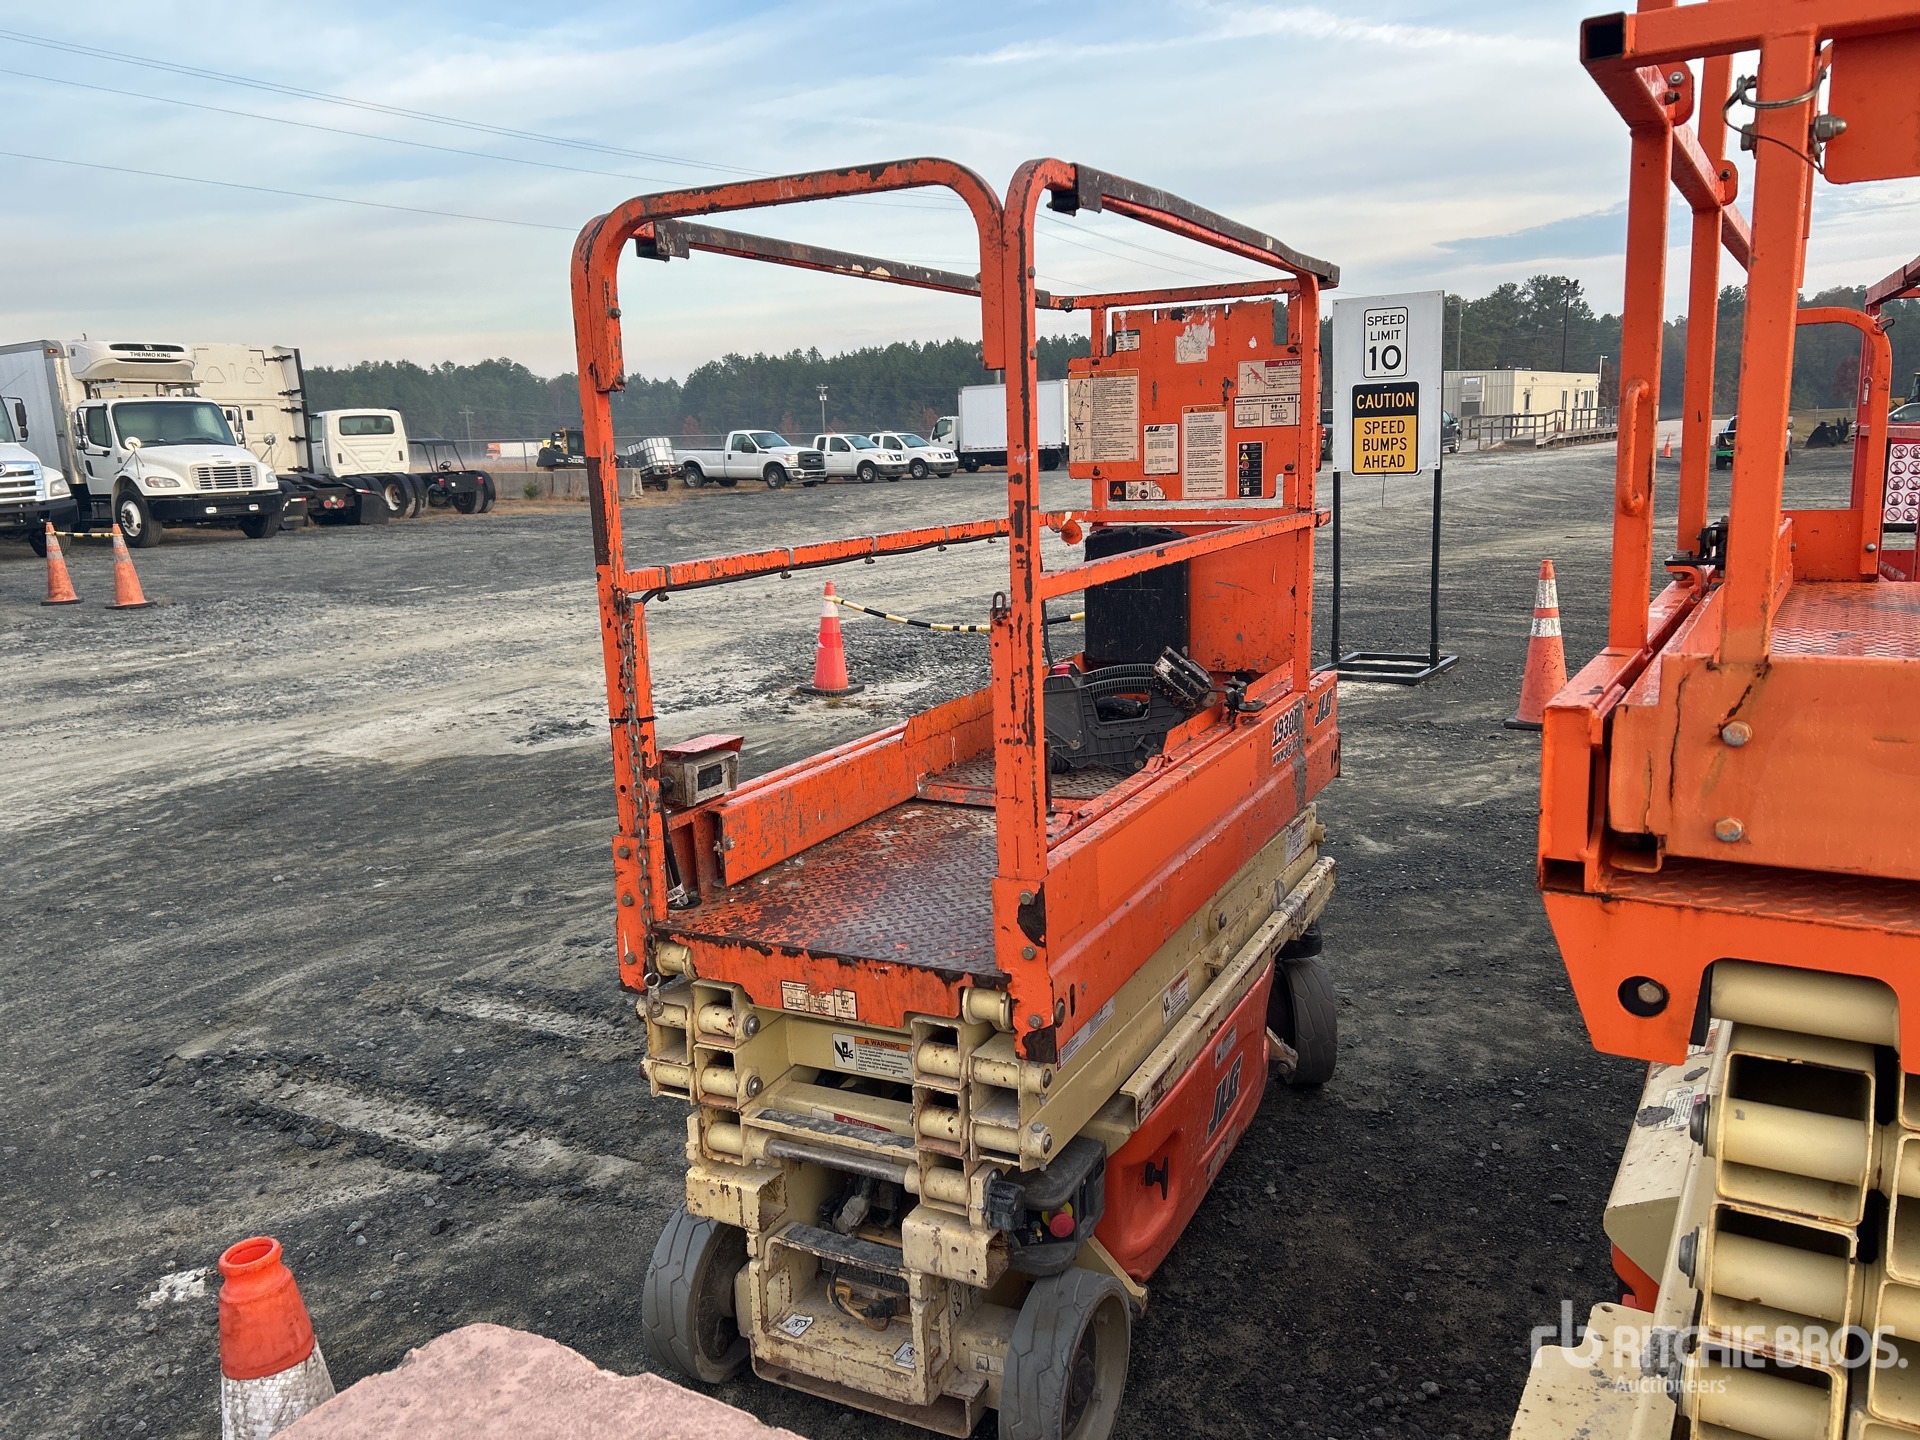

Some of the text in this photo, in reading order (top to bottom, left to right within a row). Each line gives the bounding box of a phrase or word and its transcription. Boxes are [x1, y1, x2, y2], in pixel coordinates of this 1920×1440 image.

[1366, 314, 1406, 327] SPEED
[1370, 329, 1401, 341] LIMIT
[1369, 344, 1402, 371] 10
[1356, 392, 1415, 410] CAUTION
[1145, 425, 1161, 433] JLG
[1364, 420, 1406, 435] SPEED
[1362, 437, 1407, 452] BUMPS
[1363, 454, 1405, 469] AHEAD
[1314, 687, 1334, 728] JLG
[871, 1039, 900, 1050] WARNING
[1205, 1050, 1244, 1144] JLG
